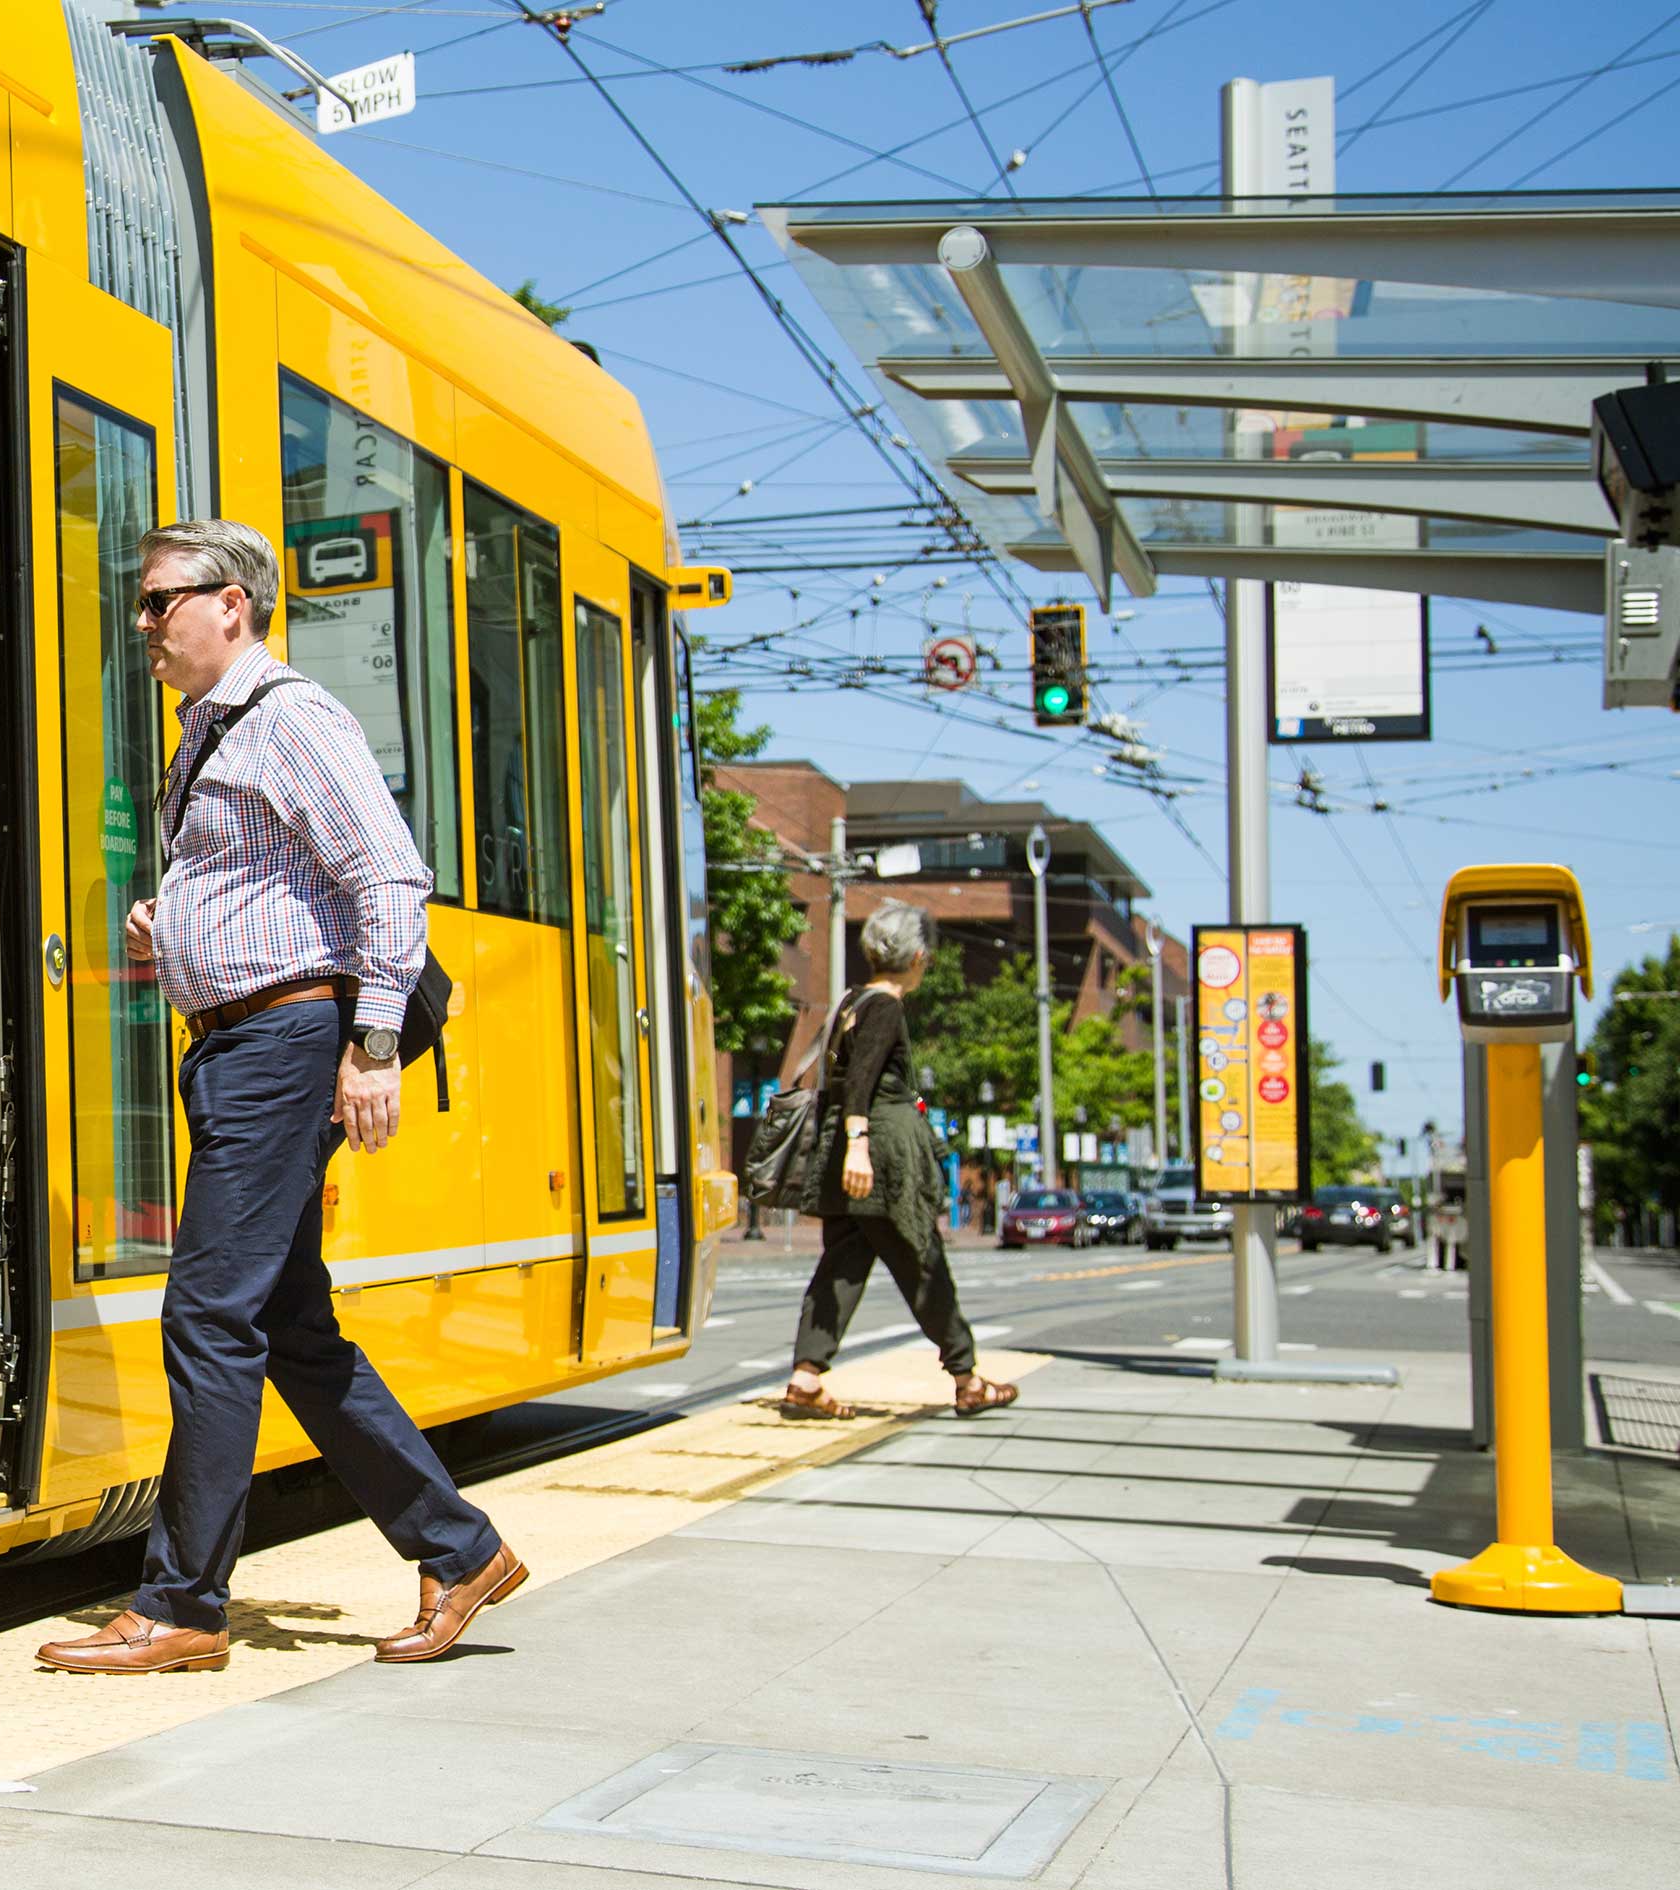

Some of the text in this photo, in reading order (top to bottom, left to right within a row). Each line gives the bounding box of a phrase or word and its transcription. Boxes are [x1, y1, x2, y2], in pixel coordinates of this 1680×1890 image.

[337, 64, 399, 96] SLOW
[333, 87, 402, 124] 5 MPH
[1285, 107, 1310, 209] SEATTL
[110, 785, 123, 802] PAY
[104, 809, 131, 829] BEFORE
[100, 834, 136, 854] BOARDING
